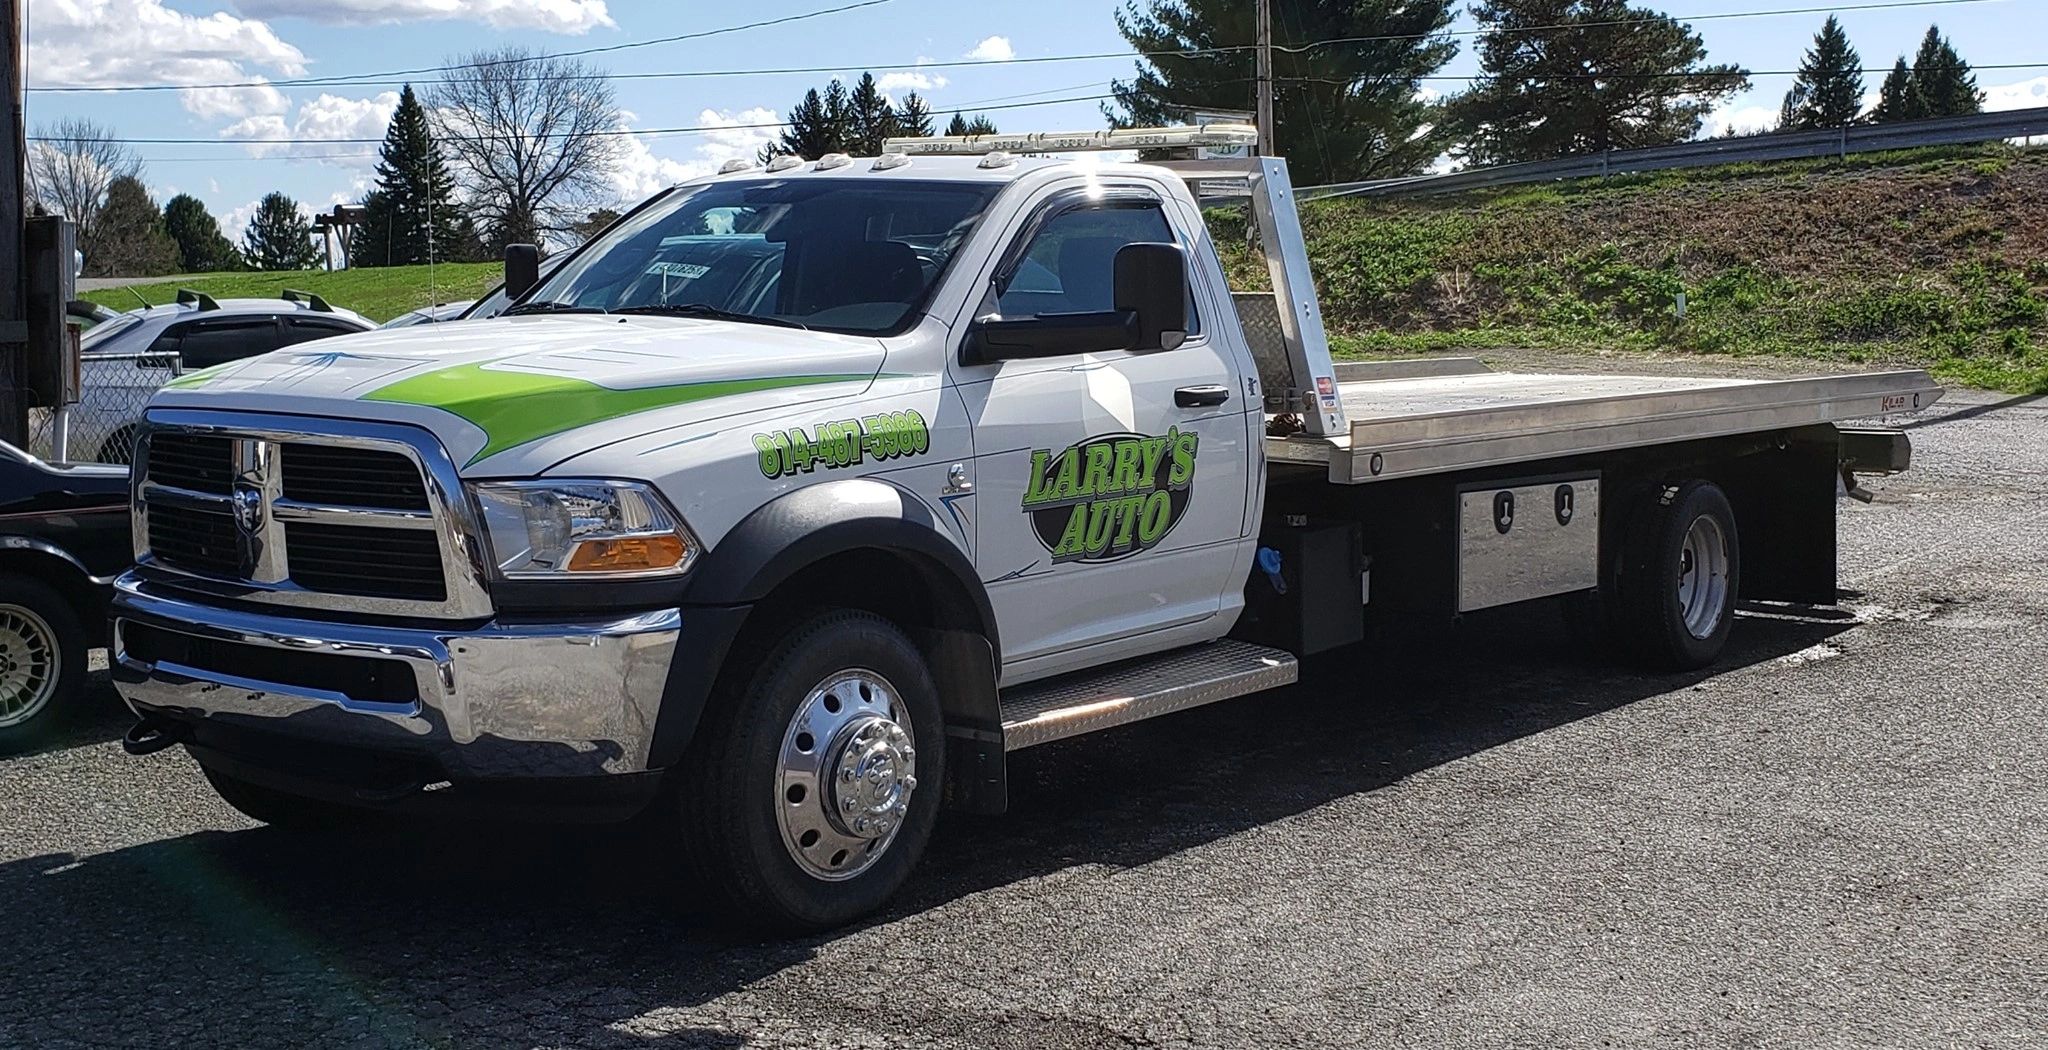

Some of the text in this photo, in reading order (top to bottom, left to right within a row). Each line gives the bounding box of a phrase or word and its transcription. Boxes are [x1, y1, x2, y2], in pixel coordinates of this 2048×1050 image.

[752, 409, 930, 480] 814-487-5986
[1022, 425, 1199, 513] LARRY'S
[1052, 490, 1172, 565] AUTO
